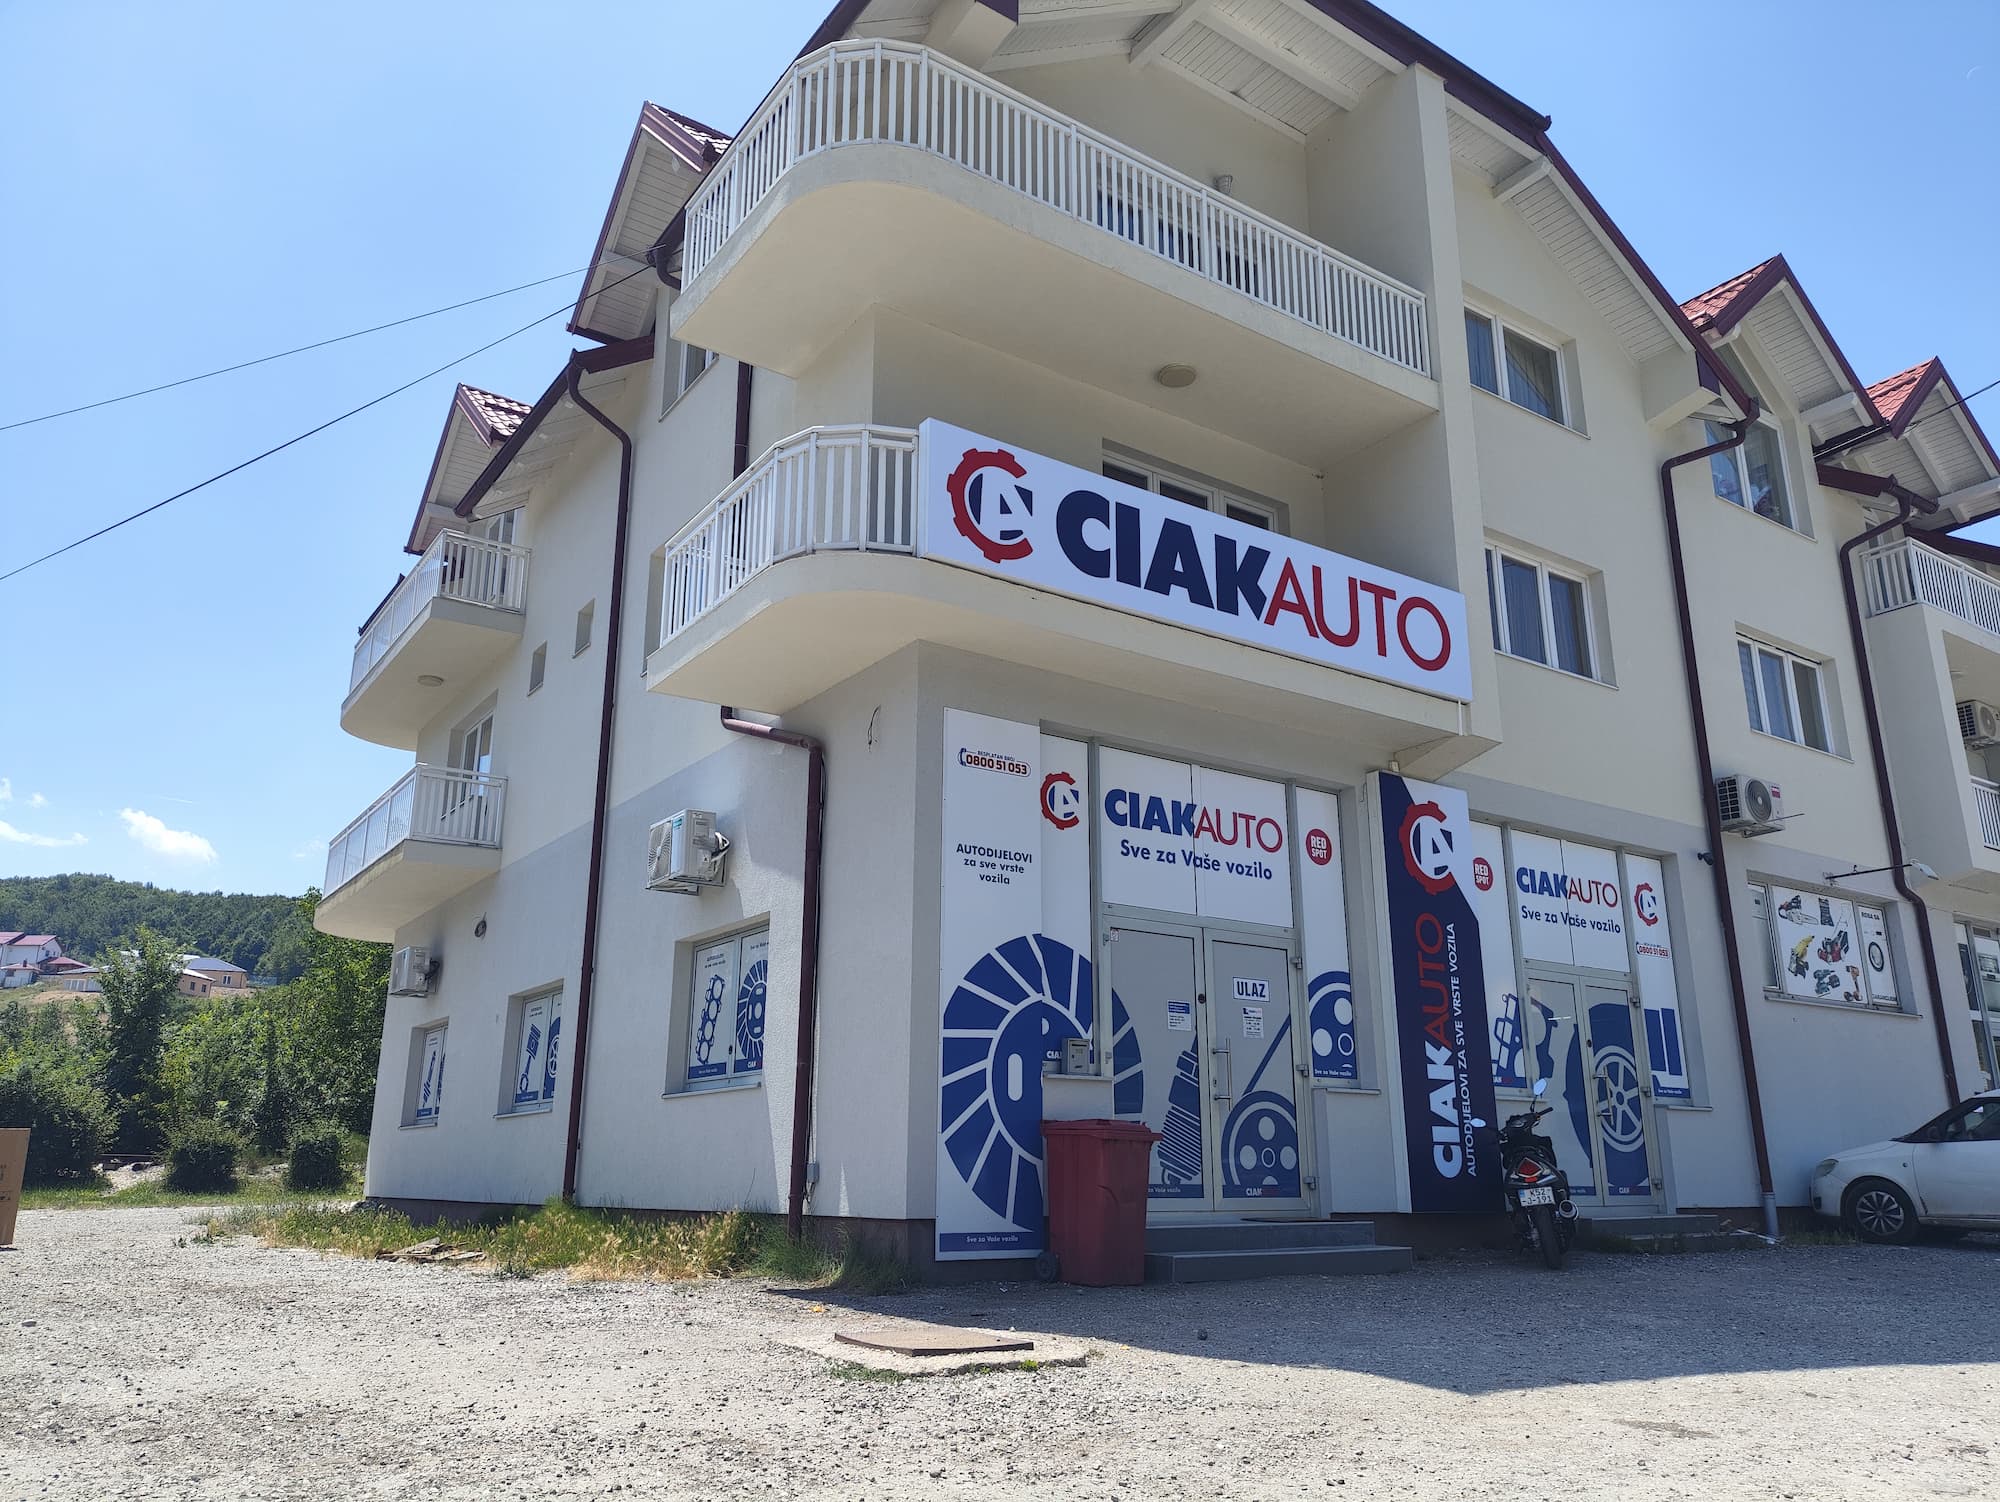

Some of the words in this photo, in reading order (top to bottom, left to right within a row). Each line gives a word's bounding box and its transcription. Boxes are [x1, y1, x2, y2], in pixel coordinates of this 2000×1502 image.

[1055, 489, 1452, 672] CIAKAUTO
[965, 754, 995, 769] 0800
[996, 760, 1006, 771] 51
[1008, 762, 1027, 775] 053
[1104, 788, 1283, 854] CIAKAUTO
[956, 843, 1033, 864] AUTODIJELOVI
[1310, 835, 1328, 850] RED
[1311, 848, 1328, 859] SPOT
[963, 858, 977, 867] za
[979, 861, 997, 870] sve
[1000, 862, 1025, 874] vrste
[1120, 839, 1151, 859] Sve
[1156, 850, 1176, 865] za
[1181, 848, 1221, 872] Vaše
[1225, 861, 1273, 880] vozilo
[1474, 863, 1489, 877] RED
[979, 873, 1010, 885] vozila
[1516, 866, 1618, 908] CIAKAUTO
[1521, 904, 1541, 921] Sve
[1544, 912, 1558, 924] za
[1560, 911, 1587, 928] Vaše
[1590, 919, 1621, 934] vozilo
[1446, 922, 1458, 973] VOZILA
[1236, 980, 1267, 998] ULAZ
[1450, 976, 1462, 1017] VRSTE
[1454, 1020, 1465, 1045] SVE
[1415, 912, 1463, 1178] CIAKAUTO
[1457, 1049, 1468, 1070] ZA
[1458, 1073, 1477, 1177] AUTODIJELOVI
[966, 1235, 977, 1243] Sve
